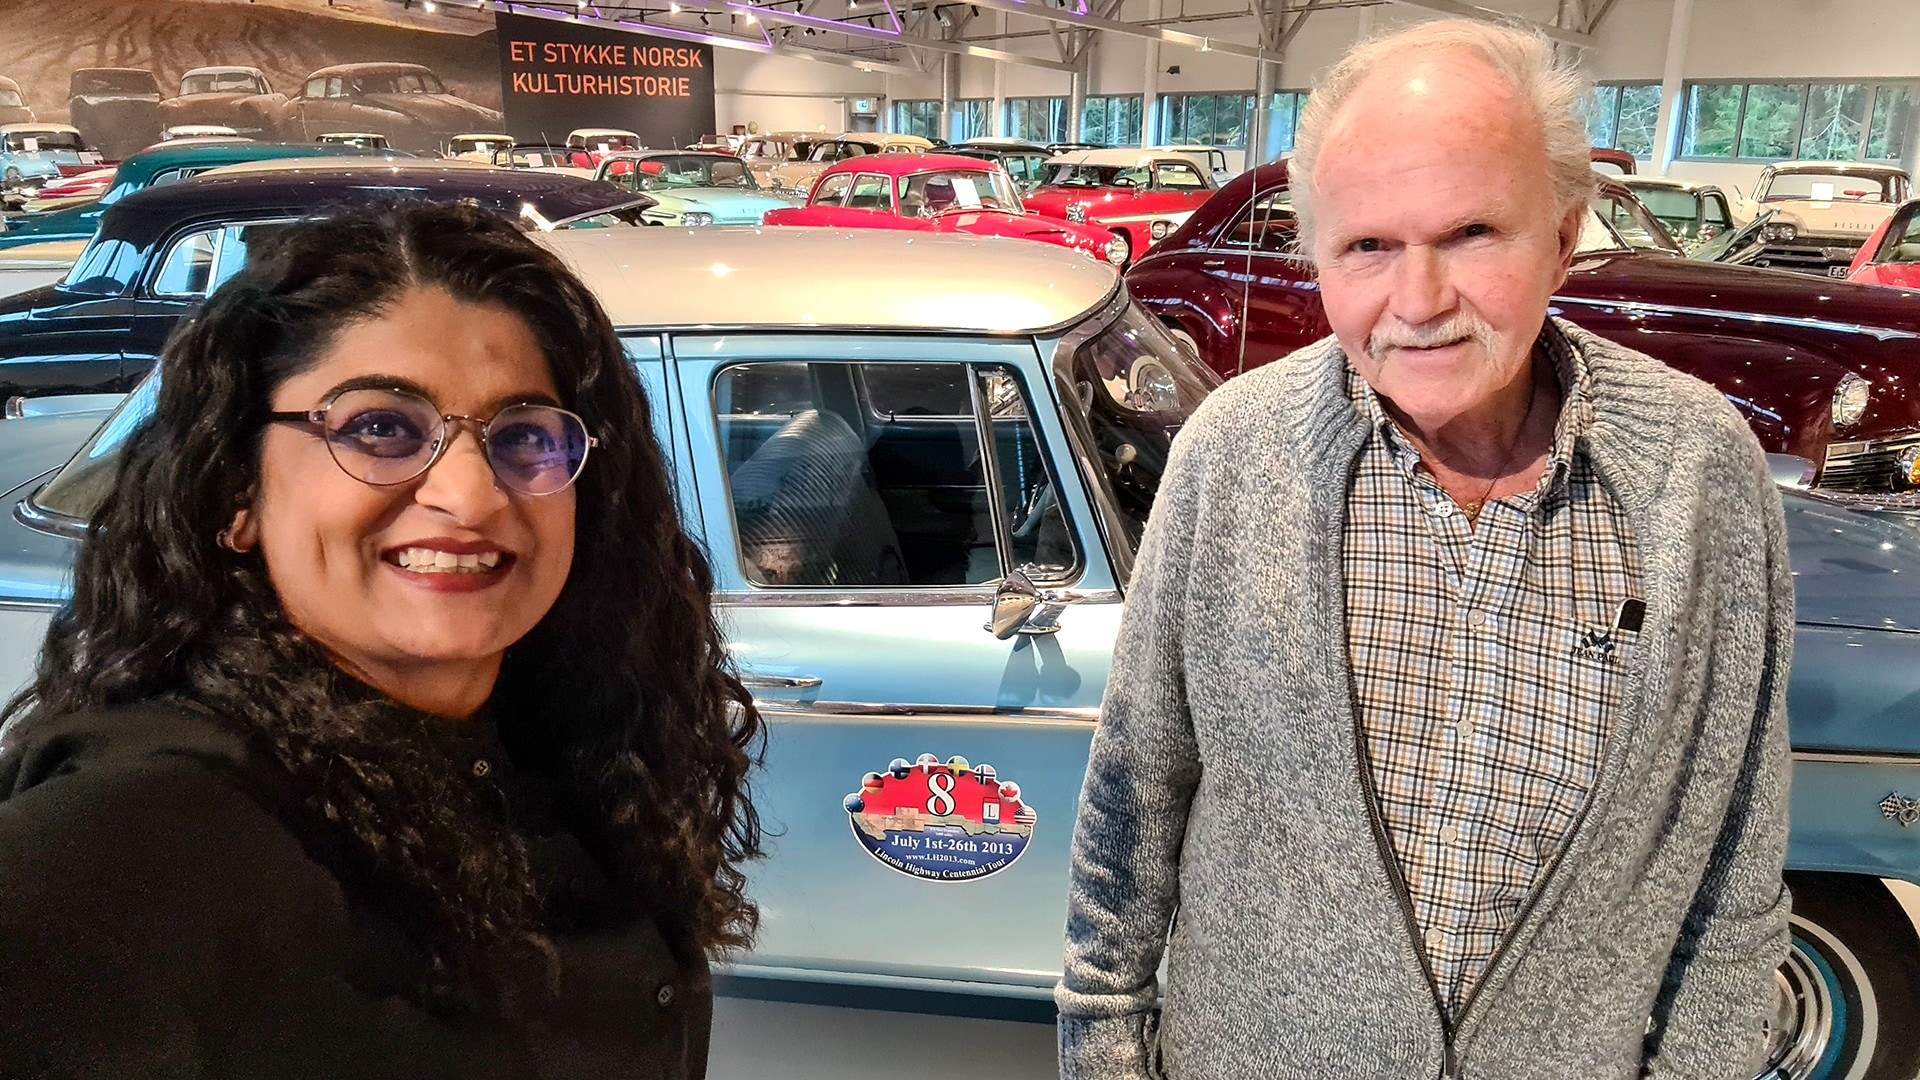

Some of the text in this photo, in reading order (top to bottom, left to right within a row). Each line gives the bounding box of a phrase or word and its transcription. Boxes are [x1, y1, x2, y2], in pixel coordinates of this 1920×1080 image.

[510, 41, 703, 68] ET STYKKE NORSK
[512, 72, 690, 97] KULTURHISTORIE
[926, 772, 956, 816] 8
[987, 804, 996, 818] L
[891, 834, 1013, 855] July 1st-26th 2013
[874, 847, 1006, 880] Lincoln Highway Centennial Tour
[905, 853, 976, 865] www.LH2013.com
